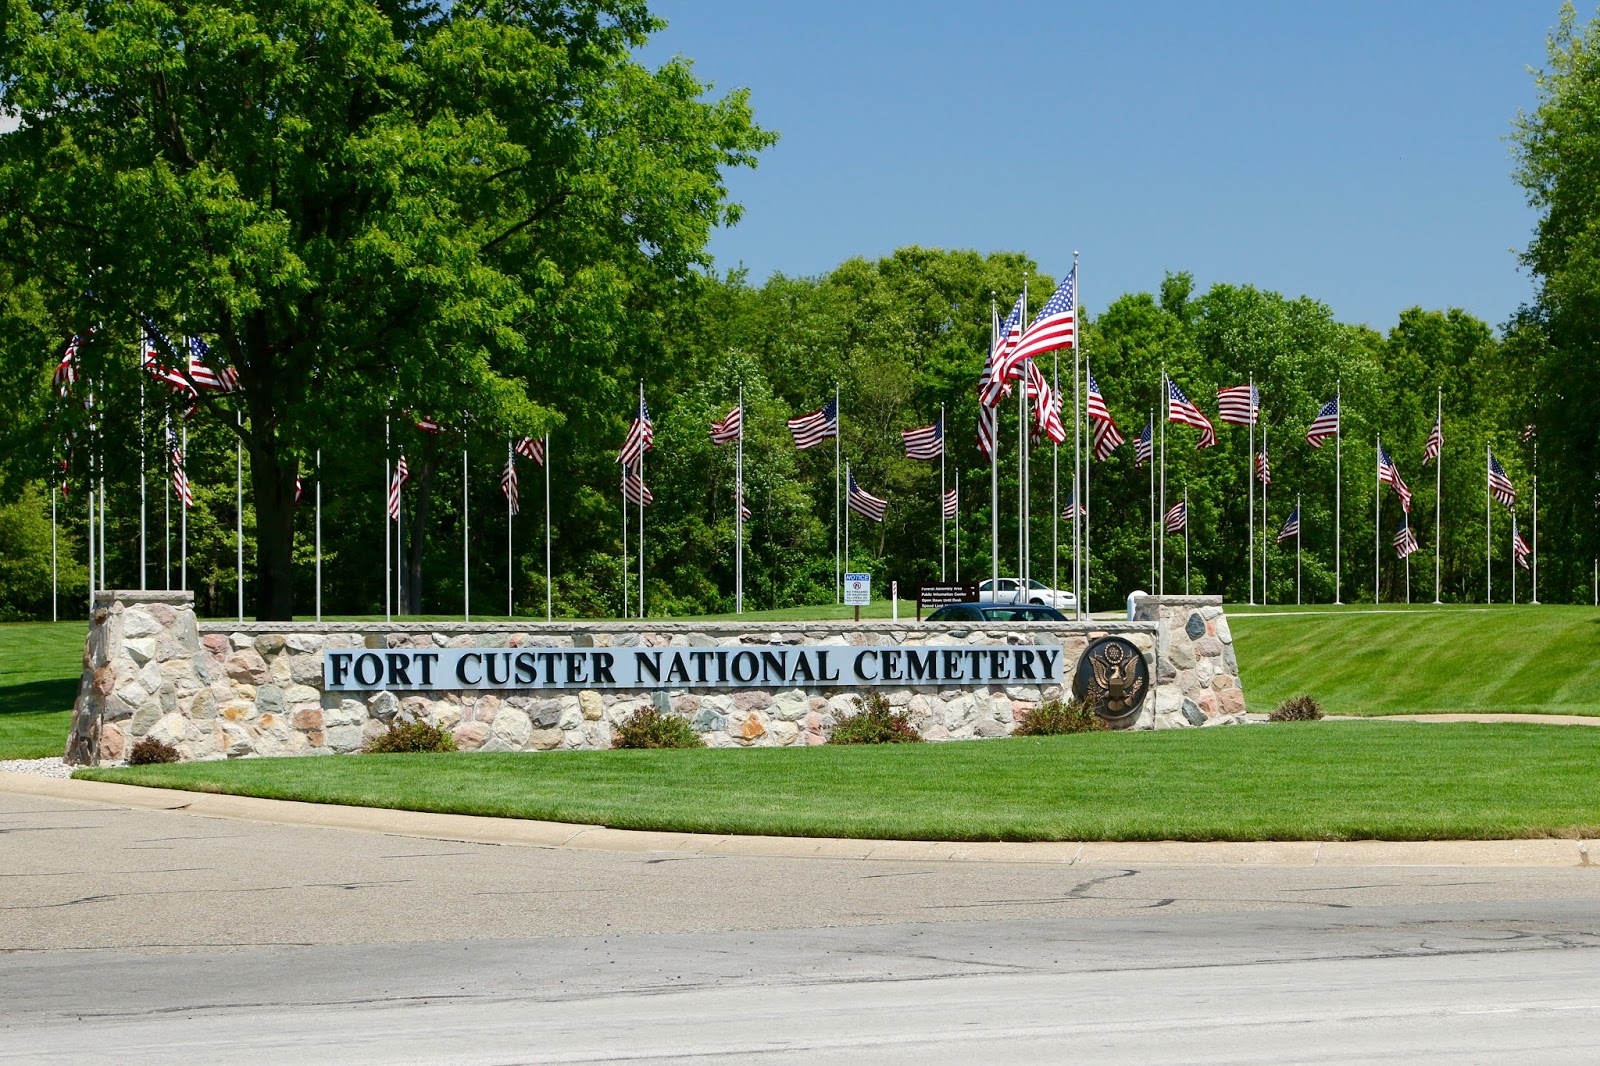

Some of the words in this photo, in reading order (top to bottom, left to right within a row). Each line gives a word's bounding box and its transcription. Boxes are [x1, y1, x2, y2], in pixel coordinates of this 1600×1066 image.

[328, 652, 439, 686] FORT
[456, 652, 616, 686] CUSTER
[634, 650, 840, 684] NATIONAL
[854, 650, 1060, 682] CEMETERY
